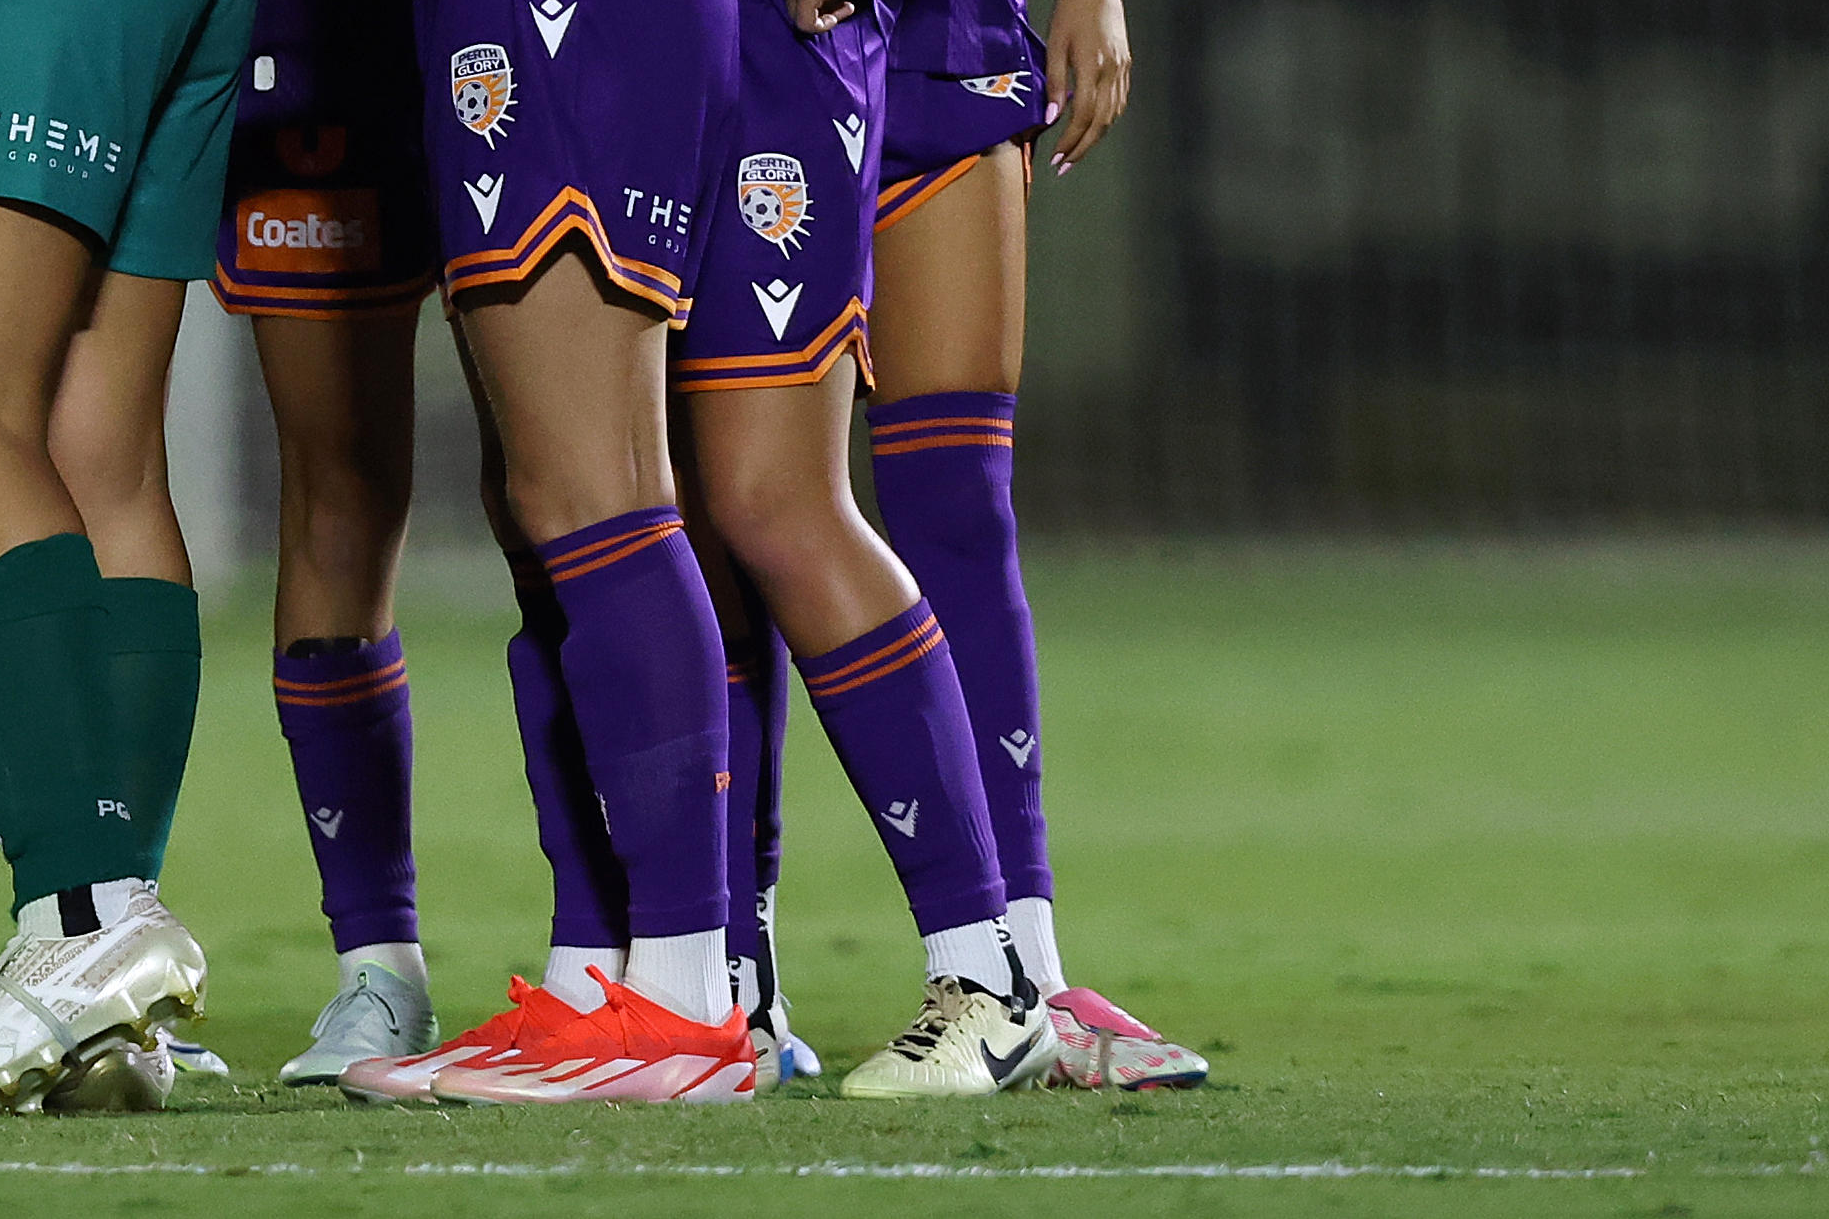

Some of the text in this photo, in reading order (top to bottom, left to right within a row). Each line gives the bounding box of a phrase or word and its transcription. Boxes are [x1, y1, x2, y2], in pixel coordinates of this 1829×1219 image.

[458, 49, 499, 65] PERTH
[457, 60, 499, 76] GLORY
[7, 150, 89, 180] GROUP
[748, 157, 794, 170] PERTH
[745, 169, 796, 181] GLORY
[246, 210, 365, 249] Coates
[97, 799, 132, 822] PG
